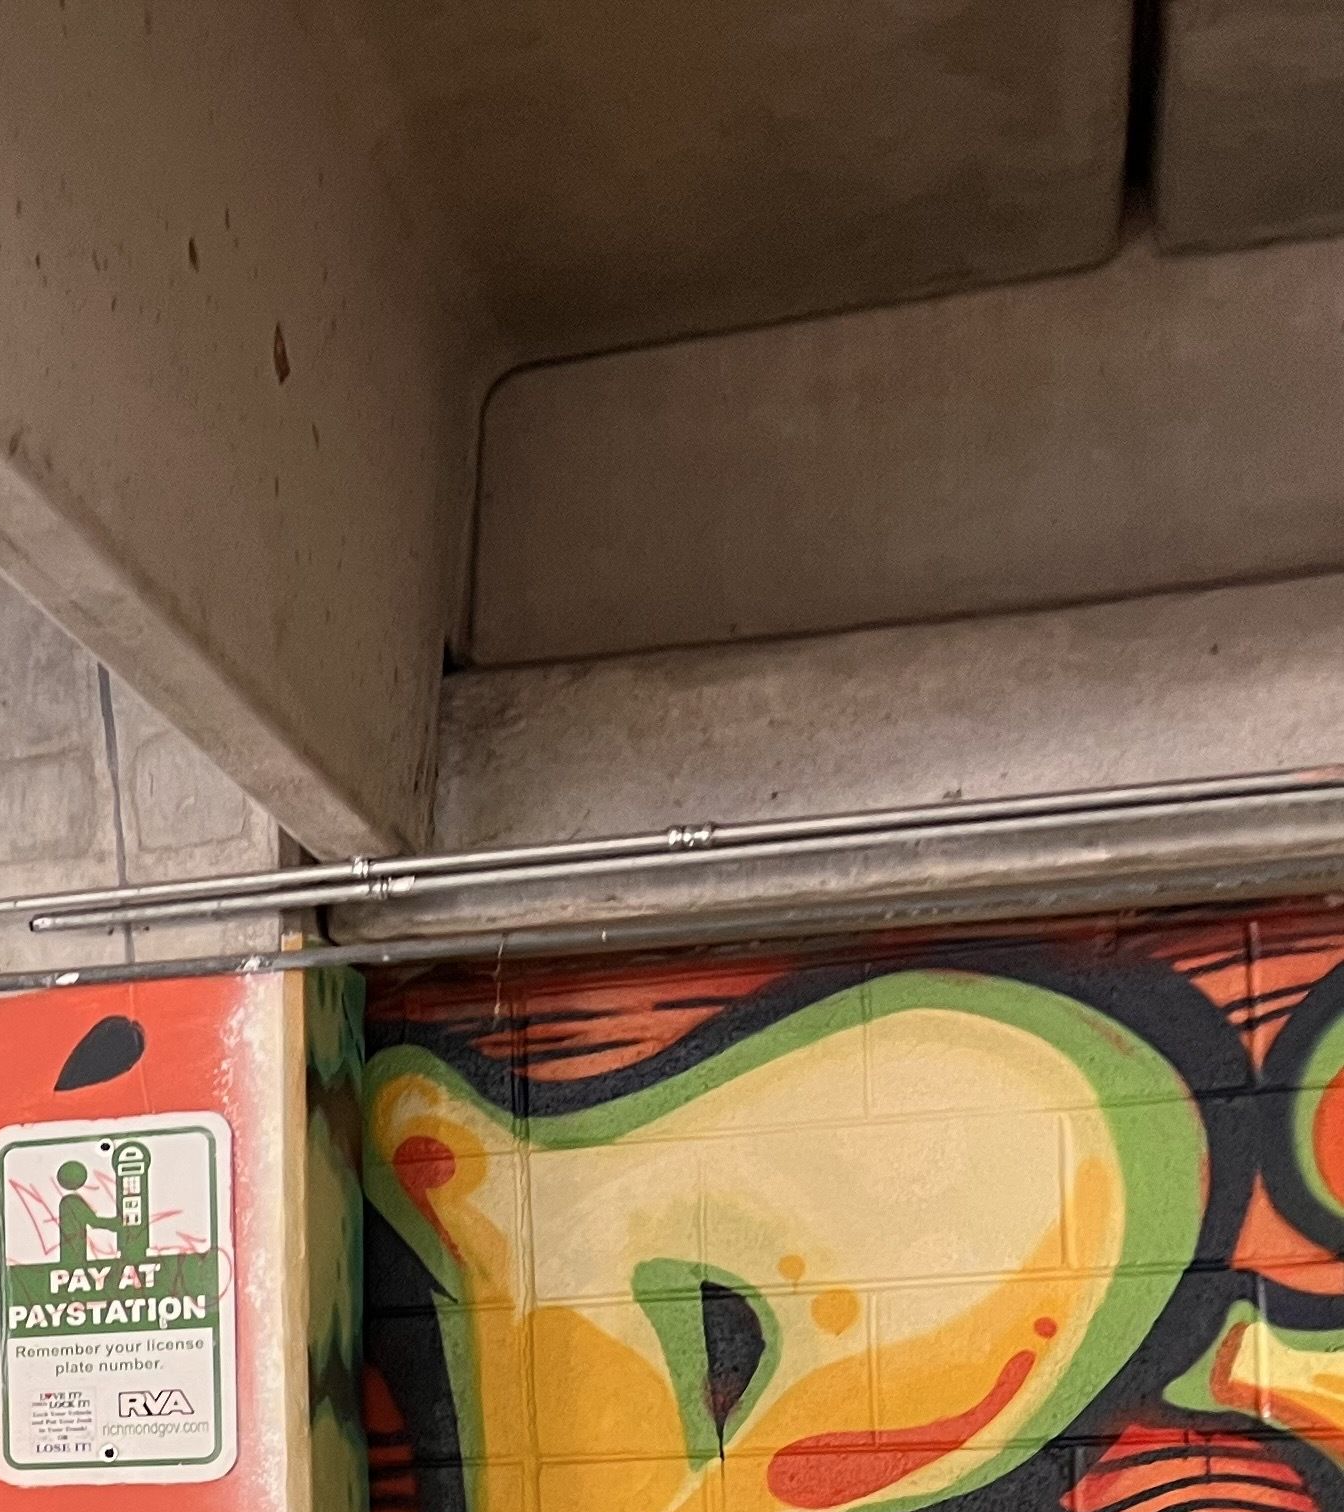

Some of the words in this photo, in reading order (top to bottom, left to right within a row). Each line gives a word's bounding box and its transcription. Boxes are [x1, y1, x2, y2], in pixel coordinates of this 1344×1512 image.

[50, 1266, 111, 1293] PAY
[119, 1264, 161, 1289] AT
[9, 1295, 205, 1329] PAYSTATION
[16, 1343, 100, 1358] Remember
[106, 1343, 142, 1357] your
[146, 1338, 204, 1351] license
[55, 1361, 93, 1376] plate
[99, 1358, 163, 1371] number.
[119, 1389, 194, 1417] RVA
[102, 1421, 209, 1438] richmondgov.com
[36, 1443, 71, 1453] LOSE
